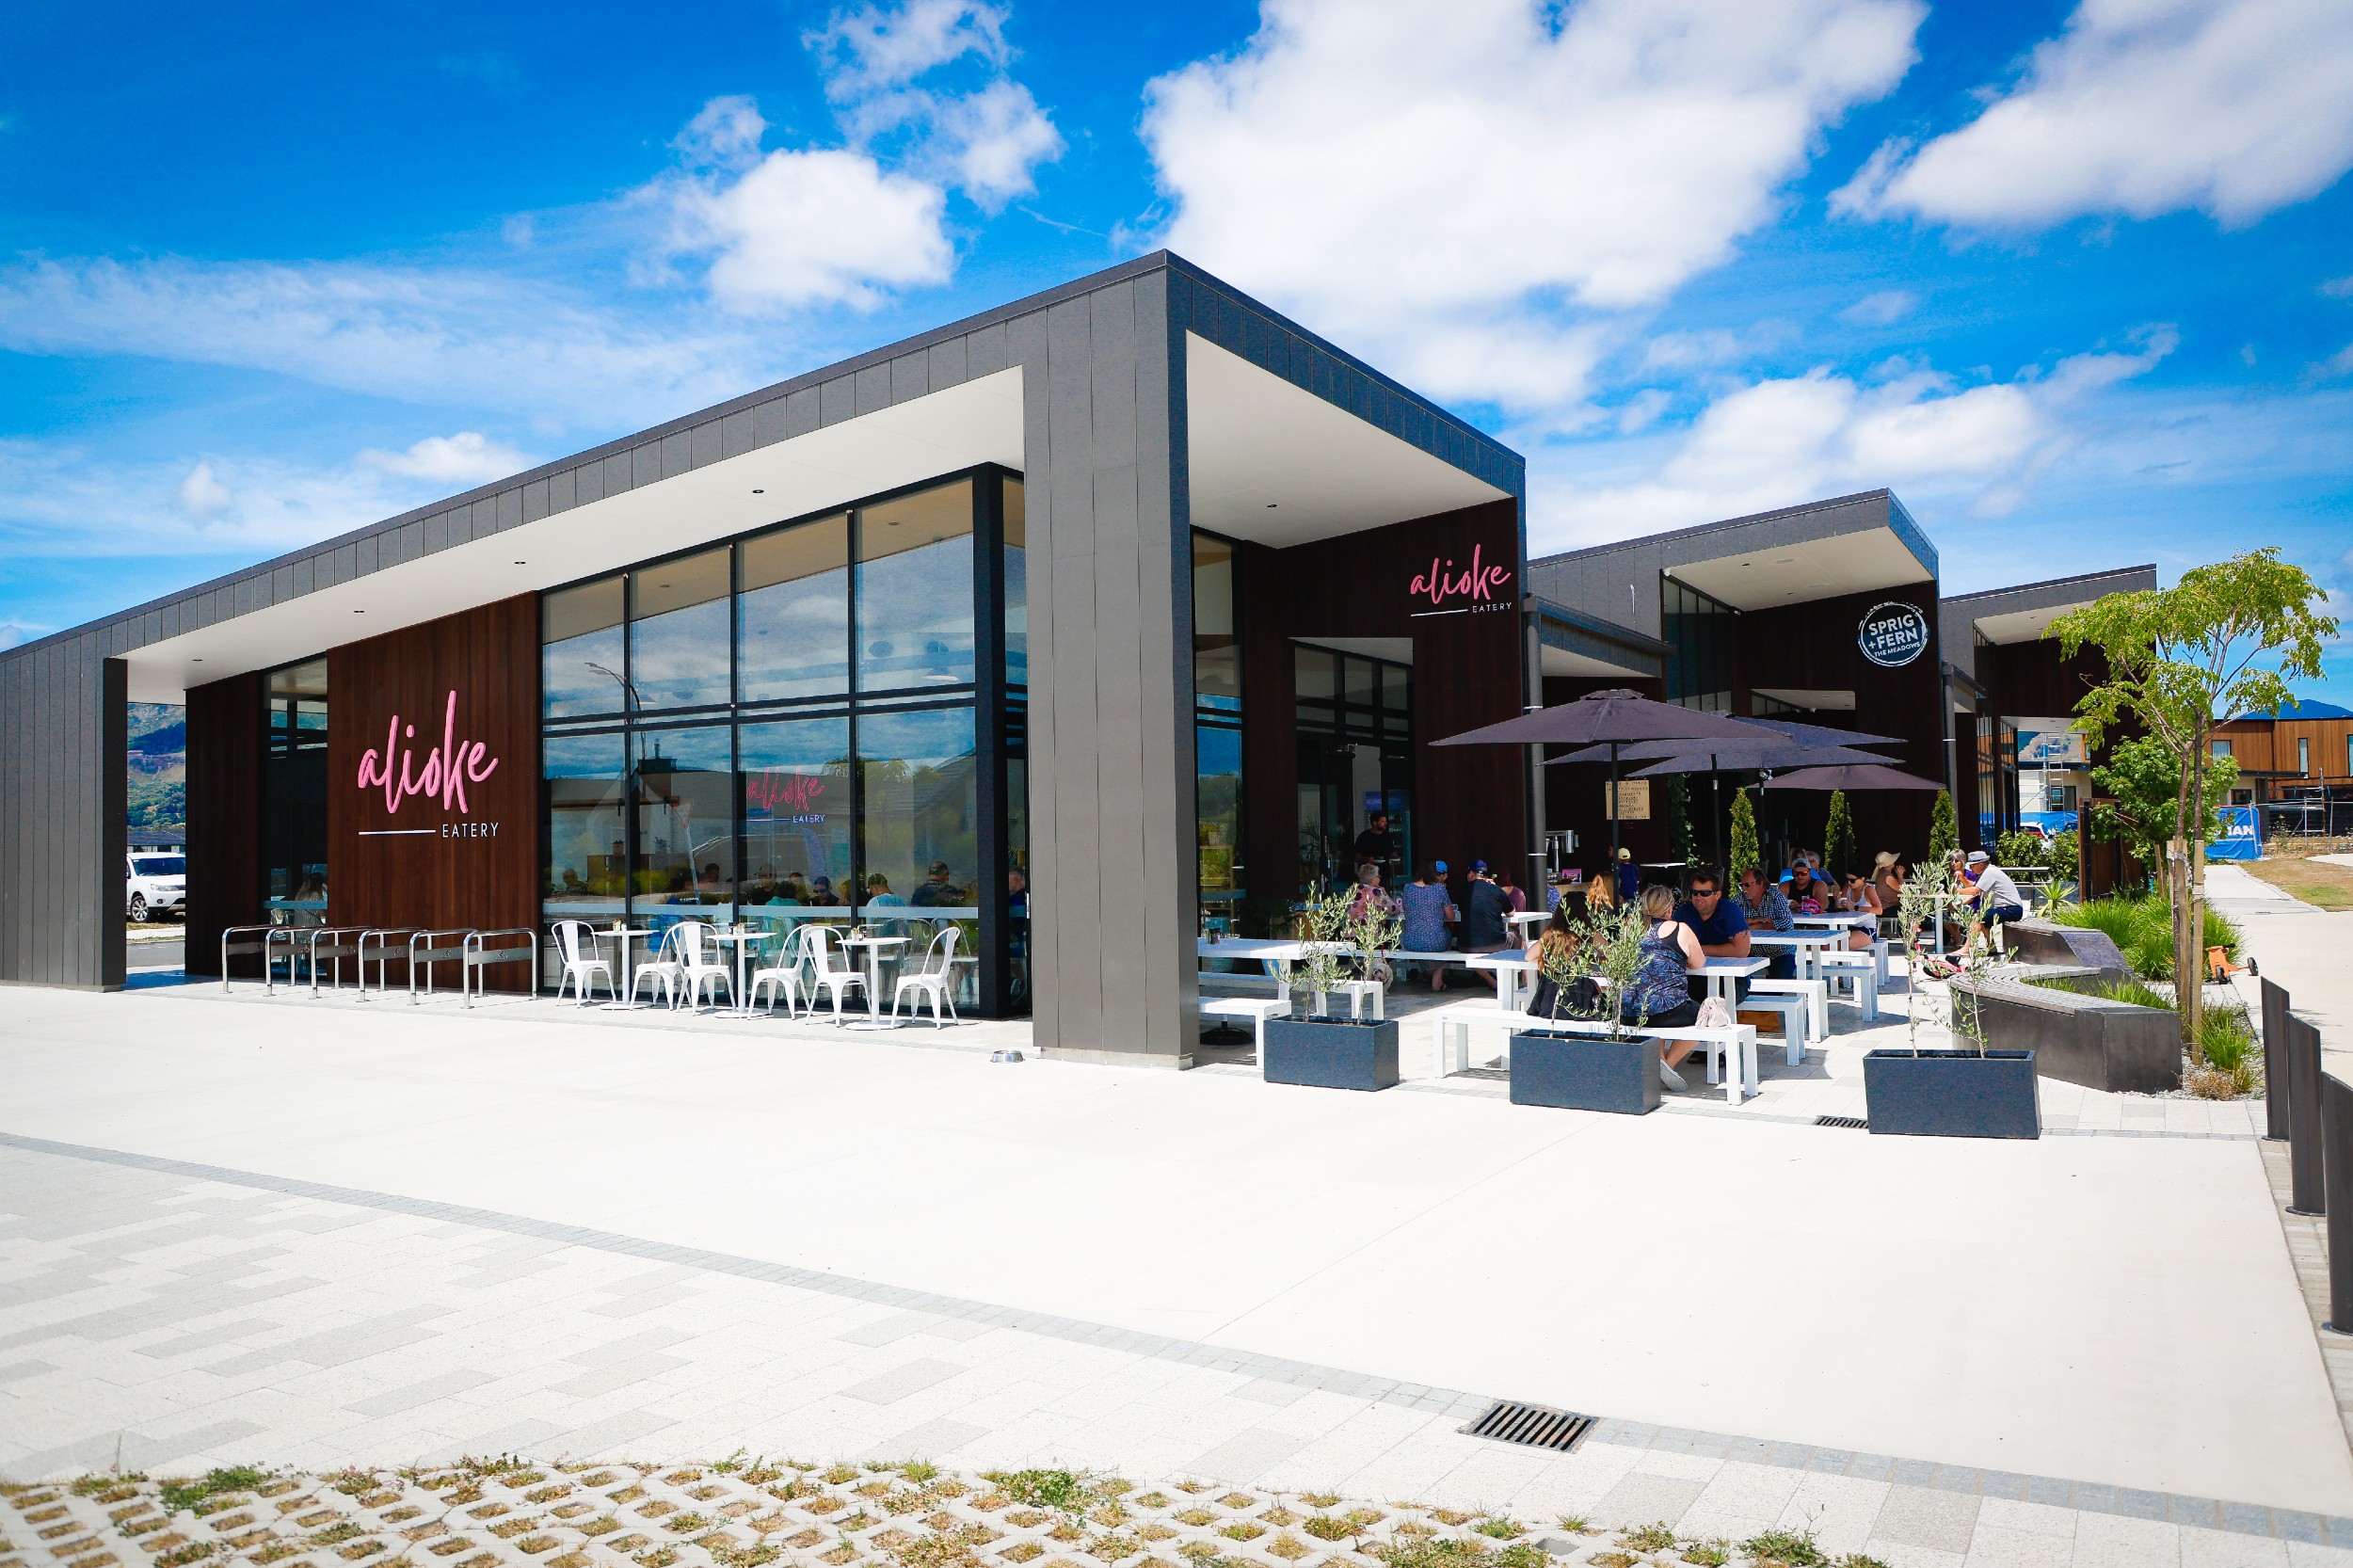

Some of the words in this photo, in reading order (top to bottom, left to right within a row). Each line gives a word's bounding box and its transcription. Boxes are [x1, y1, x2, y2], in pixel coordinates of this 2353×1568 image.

[1410, 543, 1512, 604] alioke
[1472, 602, 1513, 614] EATERY
[1868, 614, 1915, 636] SPRIG
[1874, 649, 1887, 658] THE
[1887, 641, 1921, 655] MEADOWS
[357, 690, 499, 814] alioke
[442, 822, 499, 839] EATERY
